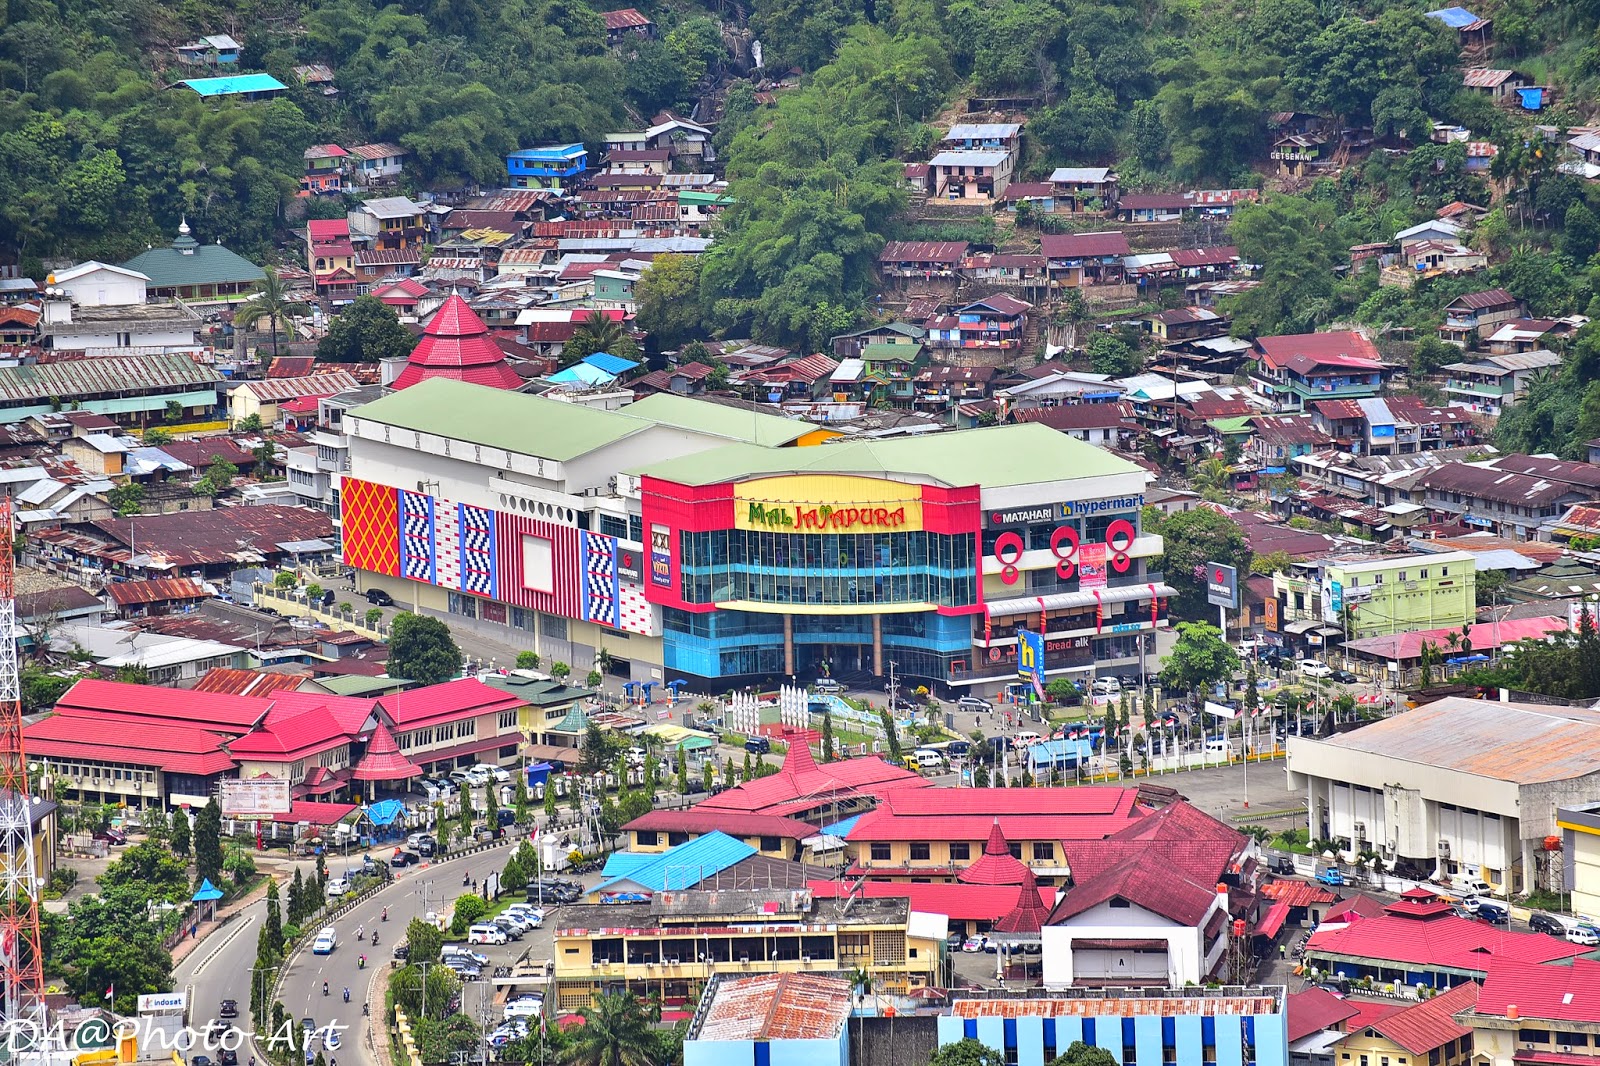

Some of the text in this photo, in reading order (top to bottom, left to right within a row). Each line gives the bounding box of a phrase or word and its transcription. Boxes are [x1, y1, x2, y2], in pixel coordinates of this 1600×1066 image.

[1075, 495, 1145, 514] hypermart
[748, 502, 906, 529] MAL JAYAPURA
[1003, 509, 1052, 524] MATAHARI
[154, 998, 182, 1006] indosat
